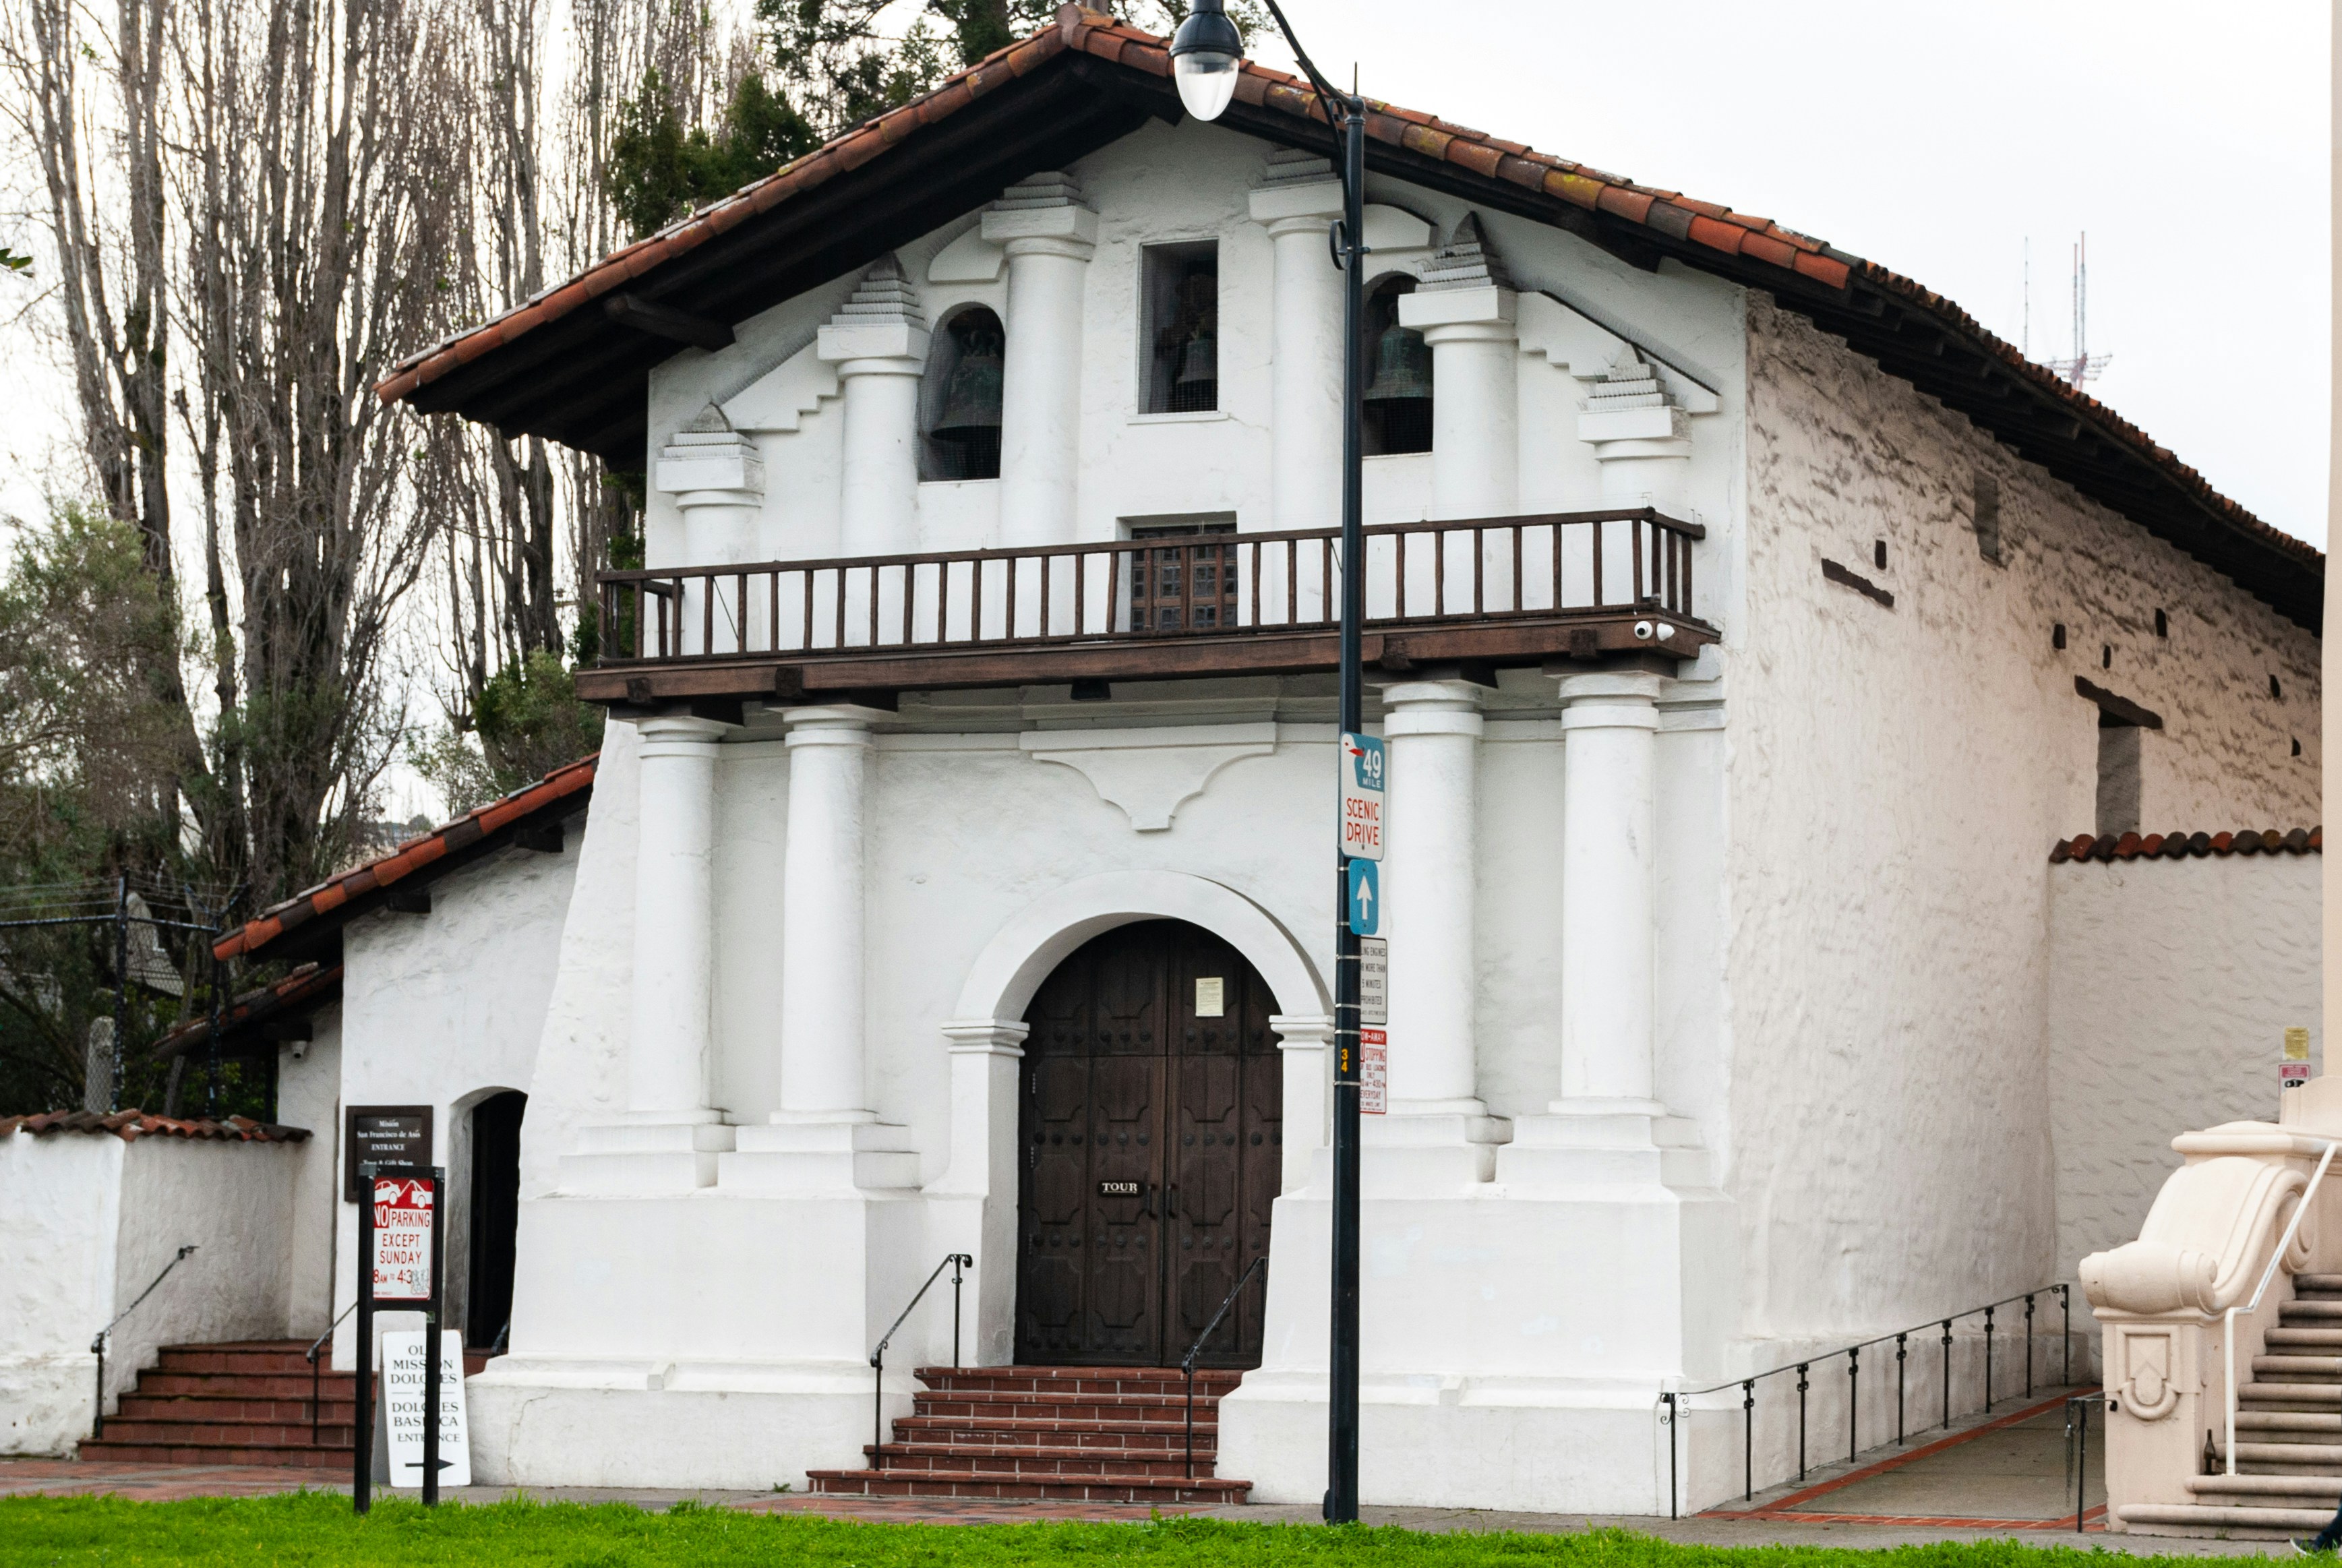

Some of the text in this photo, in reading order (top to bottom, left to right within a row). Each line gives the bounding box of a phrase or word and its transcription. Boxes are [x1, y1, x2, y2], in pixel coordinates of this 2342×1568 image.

[1363, 749, 1381, 779] 49
[1362, 777, 1381, 788] MILE
[1347, 798, 1379, 821] SCENIC
[1347, 822, 1379, 845] DRIVE
[1360, 1031, 1385, 1042] OW-AWAY
[1365, 1048, 1385, 1062] STOPPING
[1102, 1182, 1137, 1192] TOUR
[375, 1205, 430, 1228] NO PARKING
[383, 1233, 420, 1247] EXCEPT
[380, 1250, 422, 1264] SUNDAY
[408, 1345, 427, 1356] OL
[393, 1359, 453, 1370] MISSN
[391, 1373, 457, 1384] DOLOES
